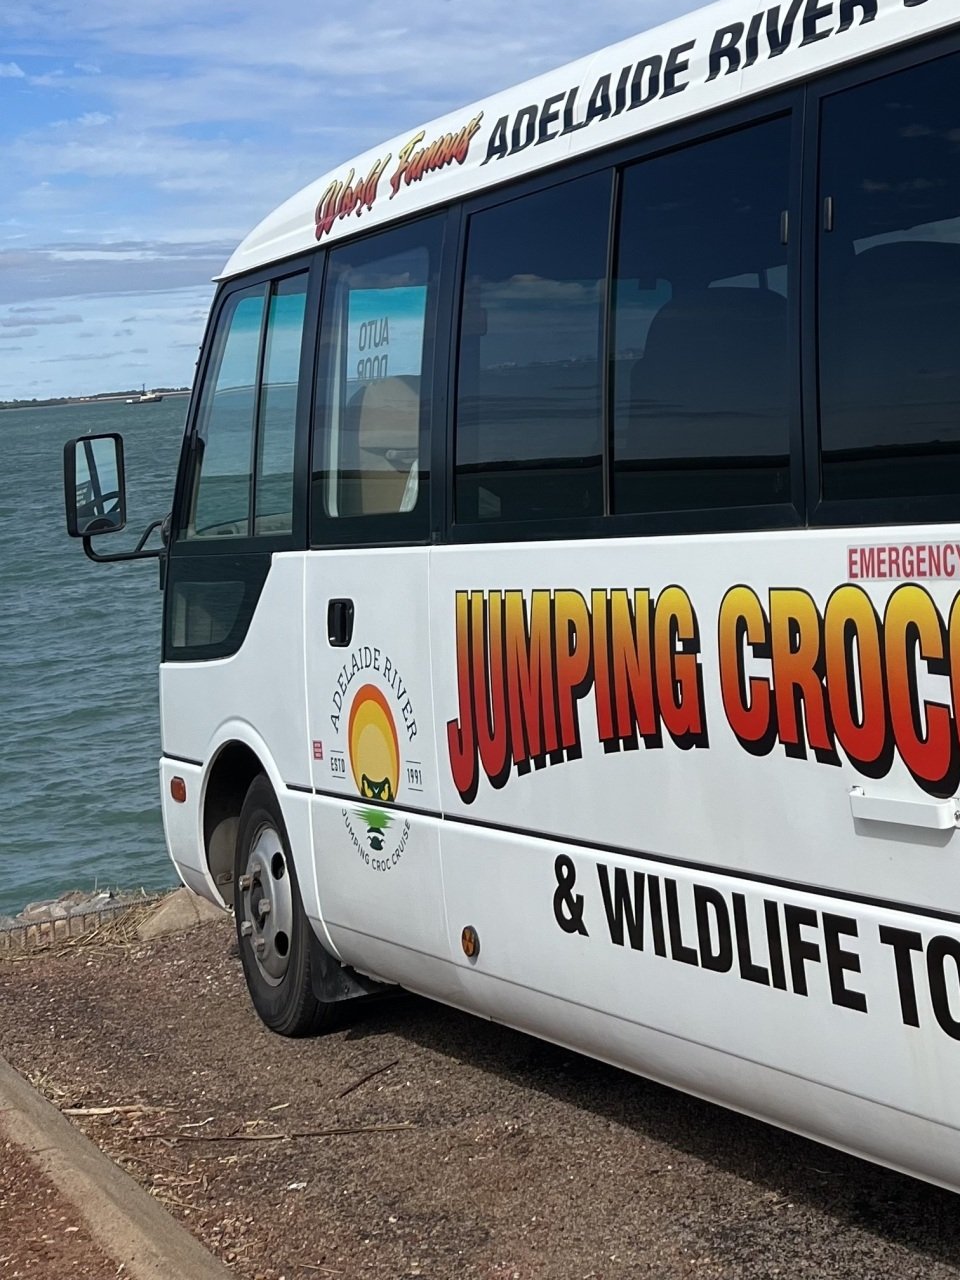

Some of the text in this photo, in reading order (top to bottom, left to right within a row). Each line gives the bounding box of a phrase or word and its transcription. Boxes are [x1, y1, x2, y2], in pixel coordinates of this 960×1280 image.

[314, 153, 392, 241] World
[389, 110, 484, 200] Famous
[479, 38, 697, 167] ADELAIDE
[330, 646, 418, 742] ADELAIDE RIVER
[446, 583, 710, 804] JUMPING
[341, 808, 411, 872] JUMPING CROC CRUISE
[406, 767, 423, 786] 1991
[552, 853, 590, 938] &
[596, 862, 868, 1014] WILDLIFE
